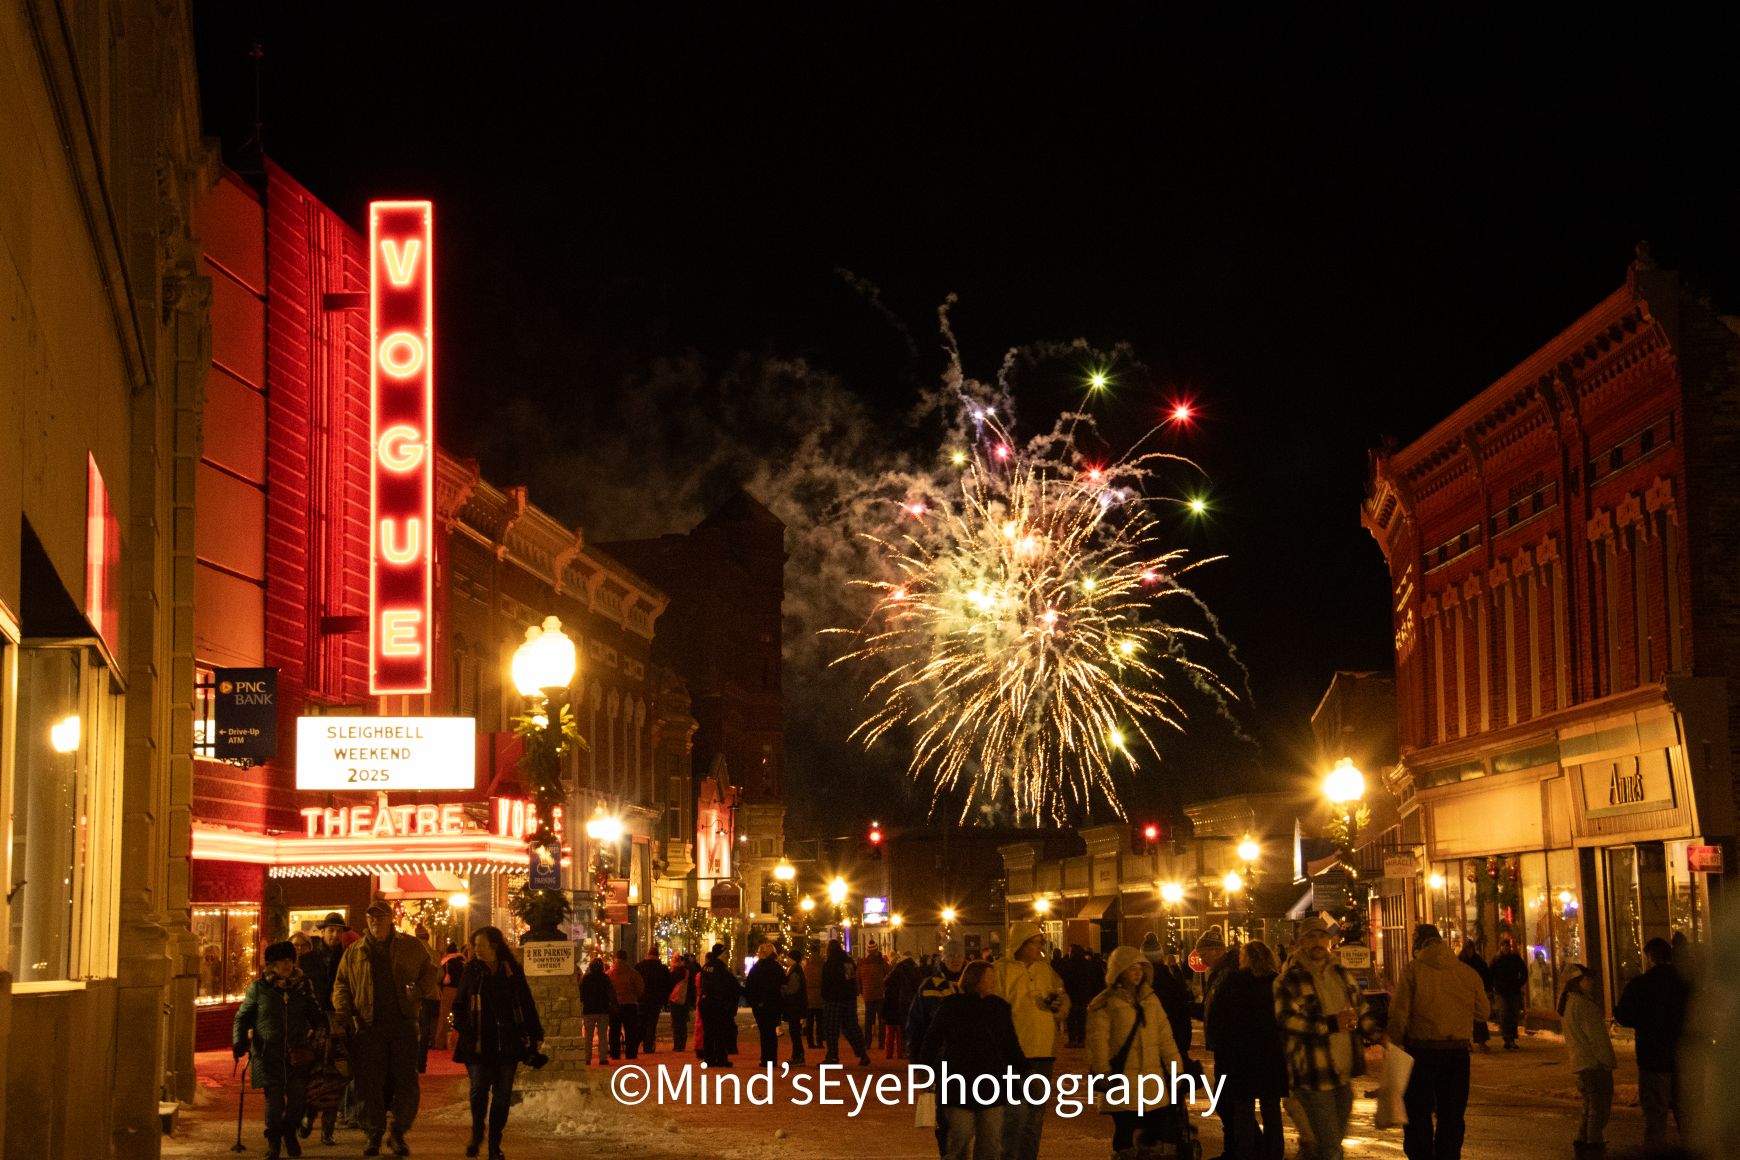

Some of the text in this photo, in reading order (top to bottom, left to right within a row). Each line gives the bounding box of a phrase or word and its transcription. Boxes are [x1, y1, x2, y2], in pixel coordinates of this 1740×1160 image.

[378, 239, 424, 656] VOGUE
[235, 681, 267, 694] PNC
[234, 693, 273, 705] BANK
[228, 728, 260, 737] Drive-Up
[326, 726, 424, 739] SLEIGHBELL
[228, 736, 245, 744] ATM
[334, 747, 411, 761] WEEKEND
[347, 768, 390, 783] 2025
[300, 804, 464, 839] THEATRE
[543, 947, 572, 957] PARKING
[532, 956, 566, 964] DOWNTOWN
